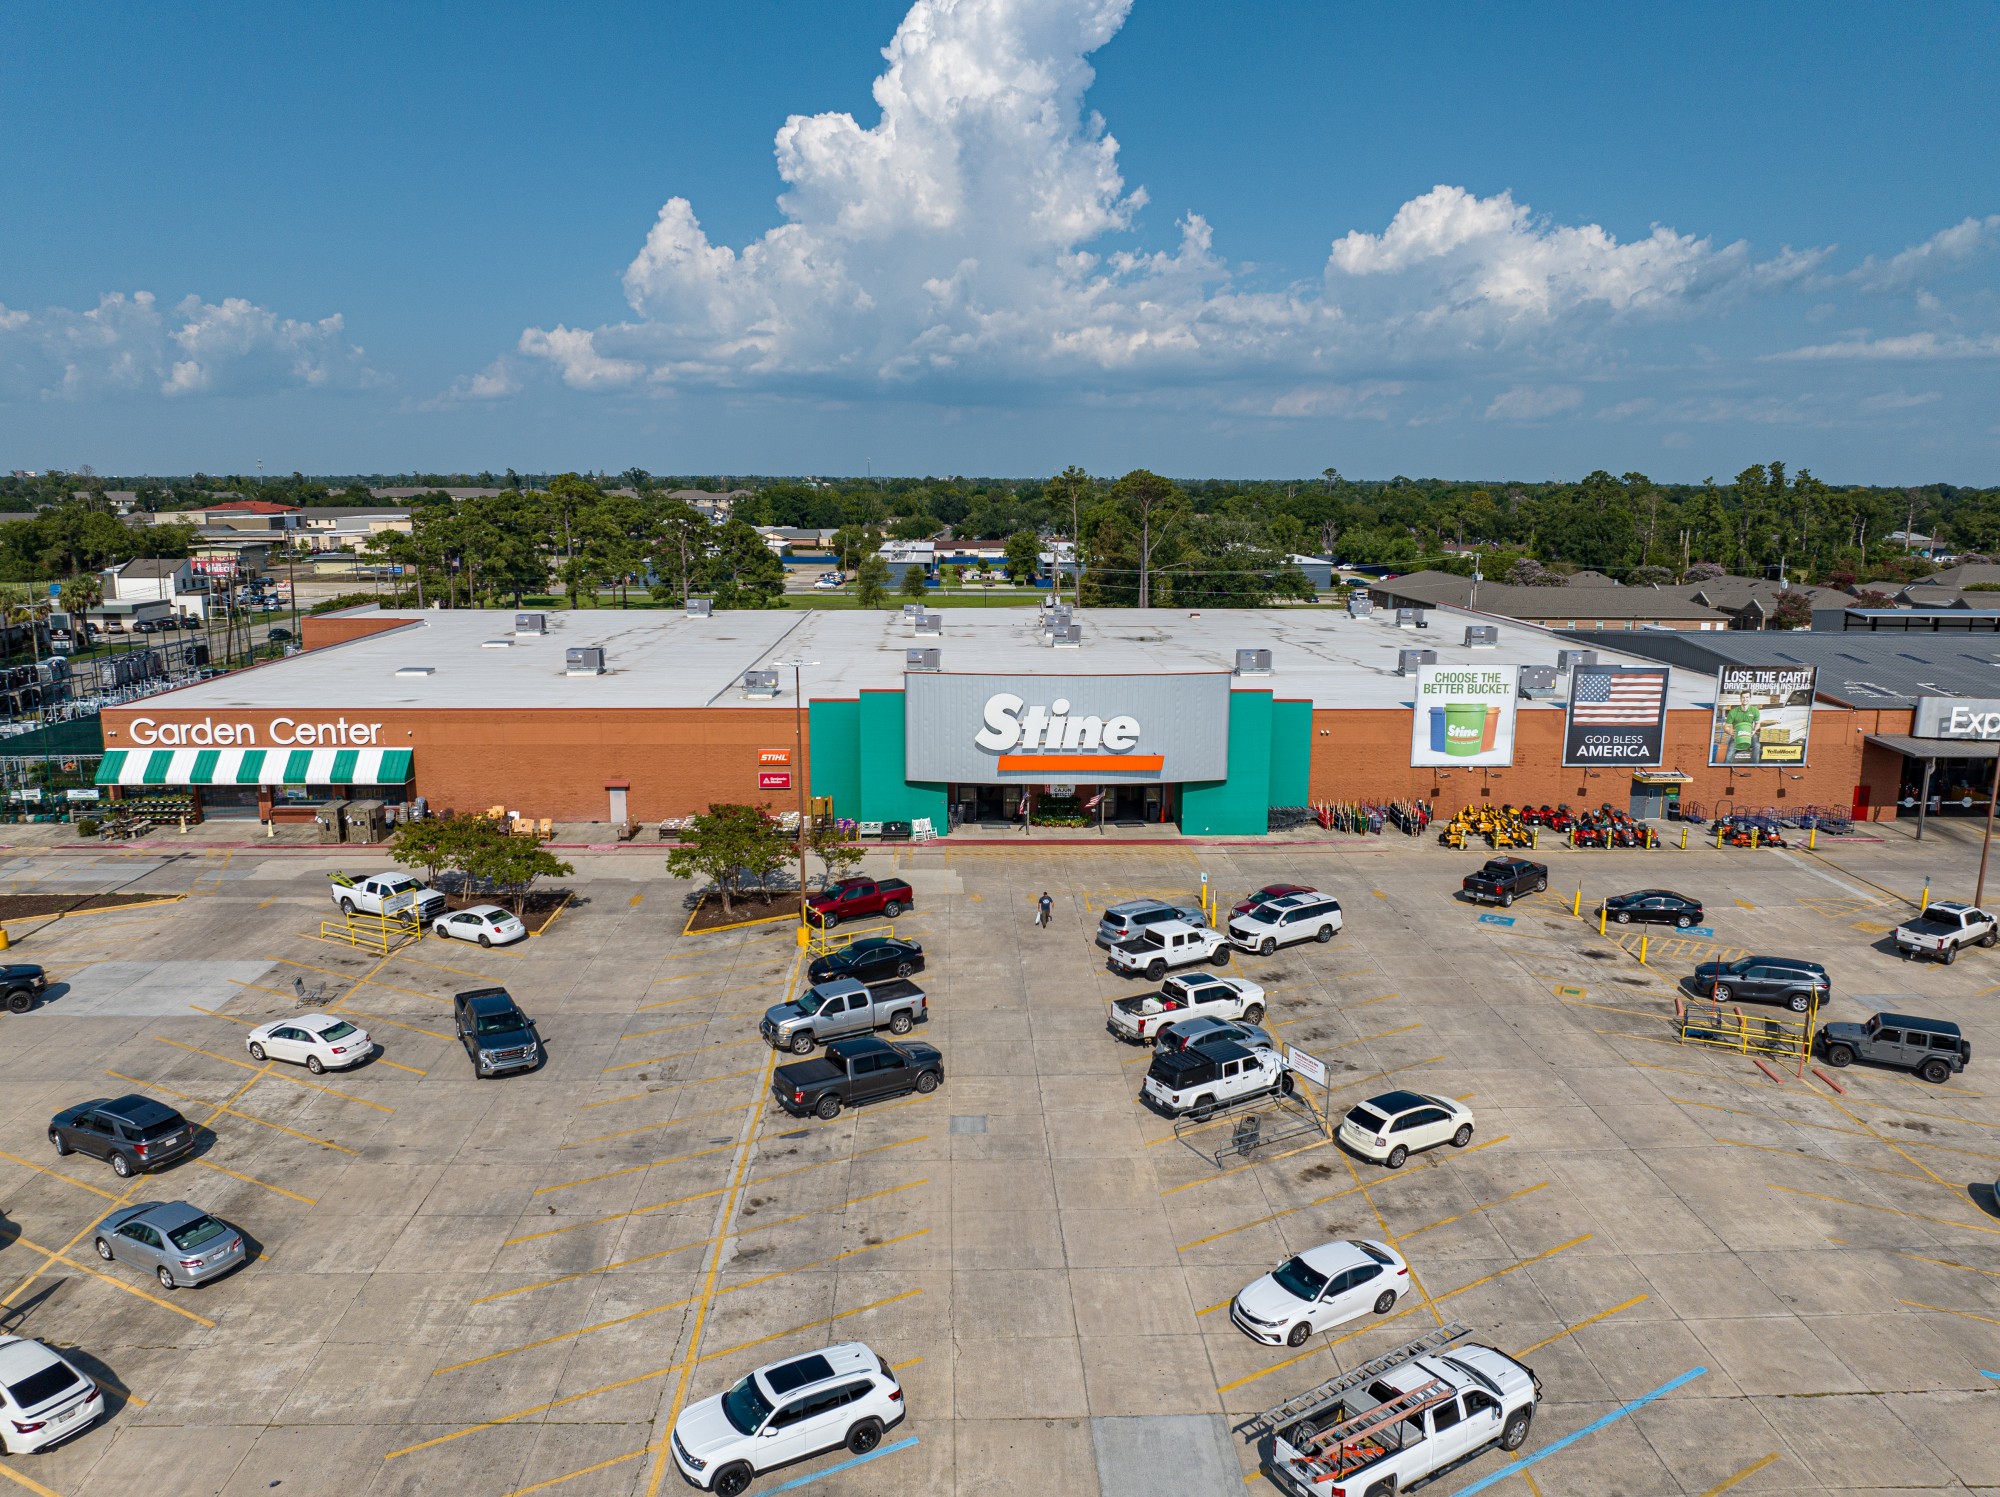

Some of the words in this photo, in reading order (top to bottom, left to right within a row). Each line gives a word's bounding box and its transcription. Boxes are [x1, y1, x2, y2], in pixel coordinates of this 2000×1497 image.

[1435, 672, 1478, 683] CHOOSE
[1481, 672, 1501, 683] THE
[1724, 671, 1753, 683] LOSE
[1755, 671, 1776, 683] THE
[1778, 671, 1811, 684] CART!
[1423, 683, 1464, 694] BETTER
[1723, 682, 1745, 690] DRIVE
[1747, 682, 1778, 690] THROUGH
[974, 693, 1140, 751] Stine
[1949, 706, 2000, 739] Exp
[129, 717, 256, 745] Garden
[269, 717, 382, 745] Center
[1447, 724, 1479, 737] Stine
[1585, 735, 1611, 744] GOD
[1613, 735, 1643, 744] BLESS
[1576, 745, 1650, 757] AMERICA
